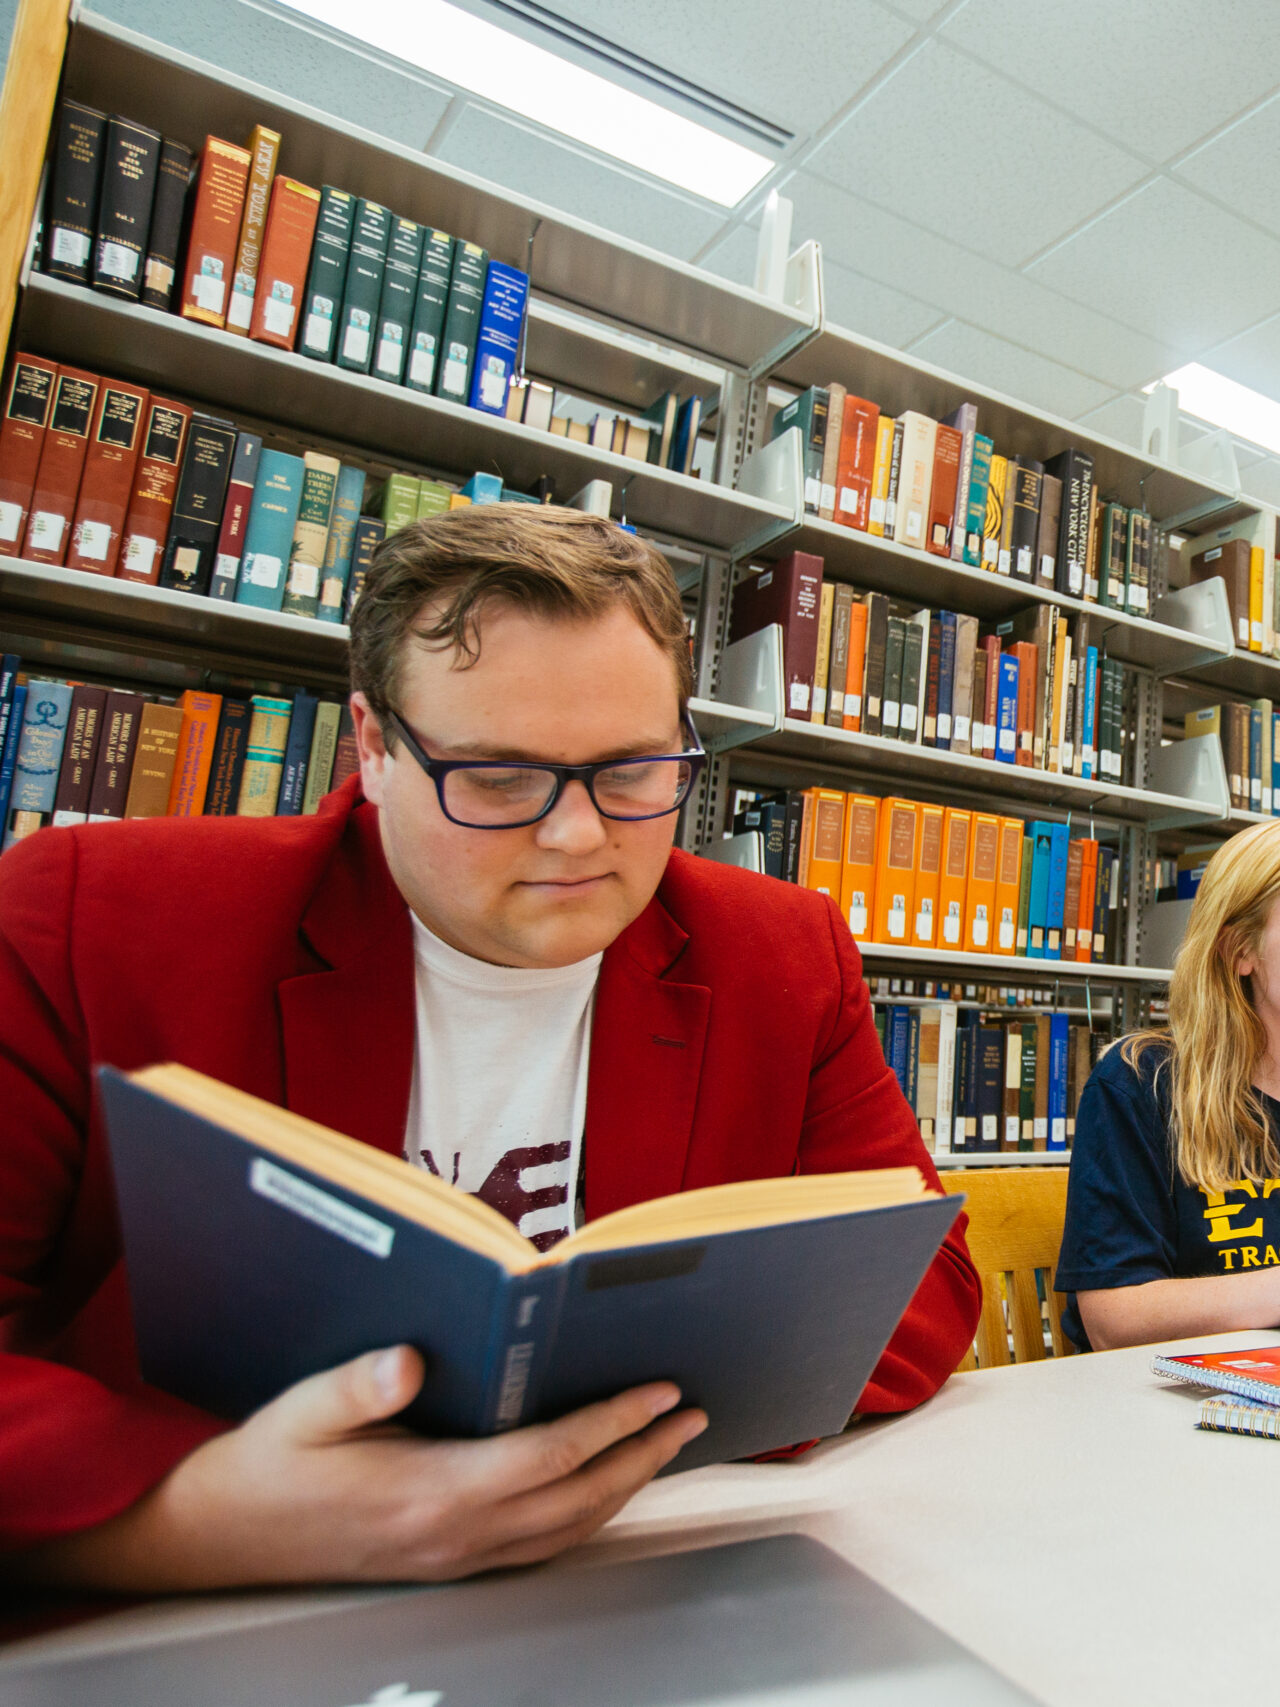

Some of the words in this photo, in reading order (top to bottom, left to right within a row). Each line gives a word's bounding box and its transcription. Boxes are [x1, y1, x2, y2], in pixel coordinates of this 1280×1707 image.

[256, 140, 274, 180] NEW
[248, 183, 267, 226] YORK
[306, 480, 333, 491] TREES
[307, 471, 333, 484] DARK
[1071, 478, 1080, 506] NEW
[234, 504, 242, 519] NEW
[230, 520, 240, 536] YORK
[1069, 508, 1079, 538] YORK
[1078, 482, 1091, 566] ENCYCLOPEDIA
[73, 707, 86, 743] AMERICAN
[86, 708, 98, 739] MEMOIRS
[109, 711, 123, 745] AMERICAN
[120, 712, 132, 743] MEMOIRS
[150, 729, 179, 739] HISTORY
[70, 741, 80, 760] LADY
[84, 739, 92, 749] OF
[118, 743, 128, 754] OF
[140, 744, 156, 752] NEW
[158, 747, 176, 755] YORK
[81, 750, 90, 760] AN
[106, 744, 115, 764] LADY
[116, 754, 125, 764] AN
